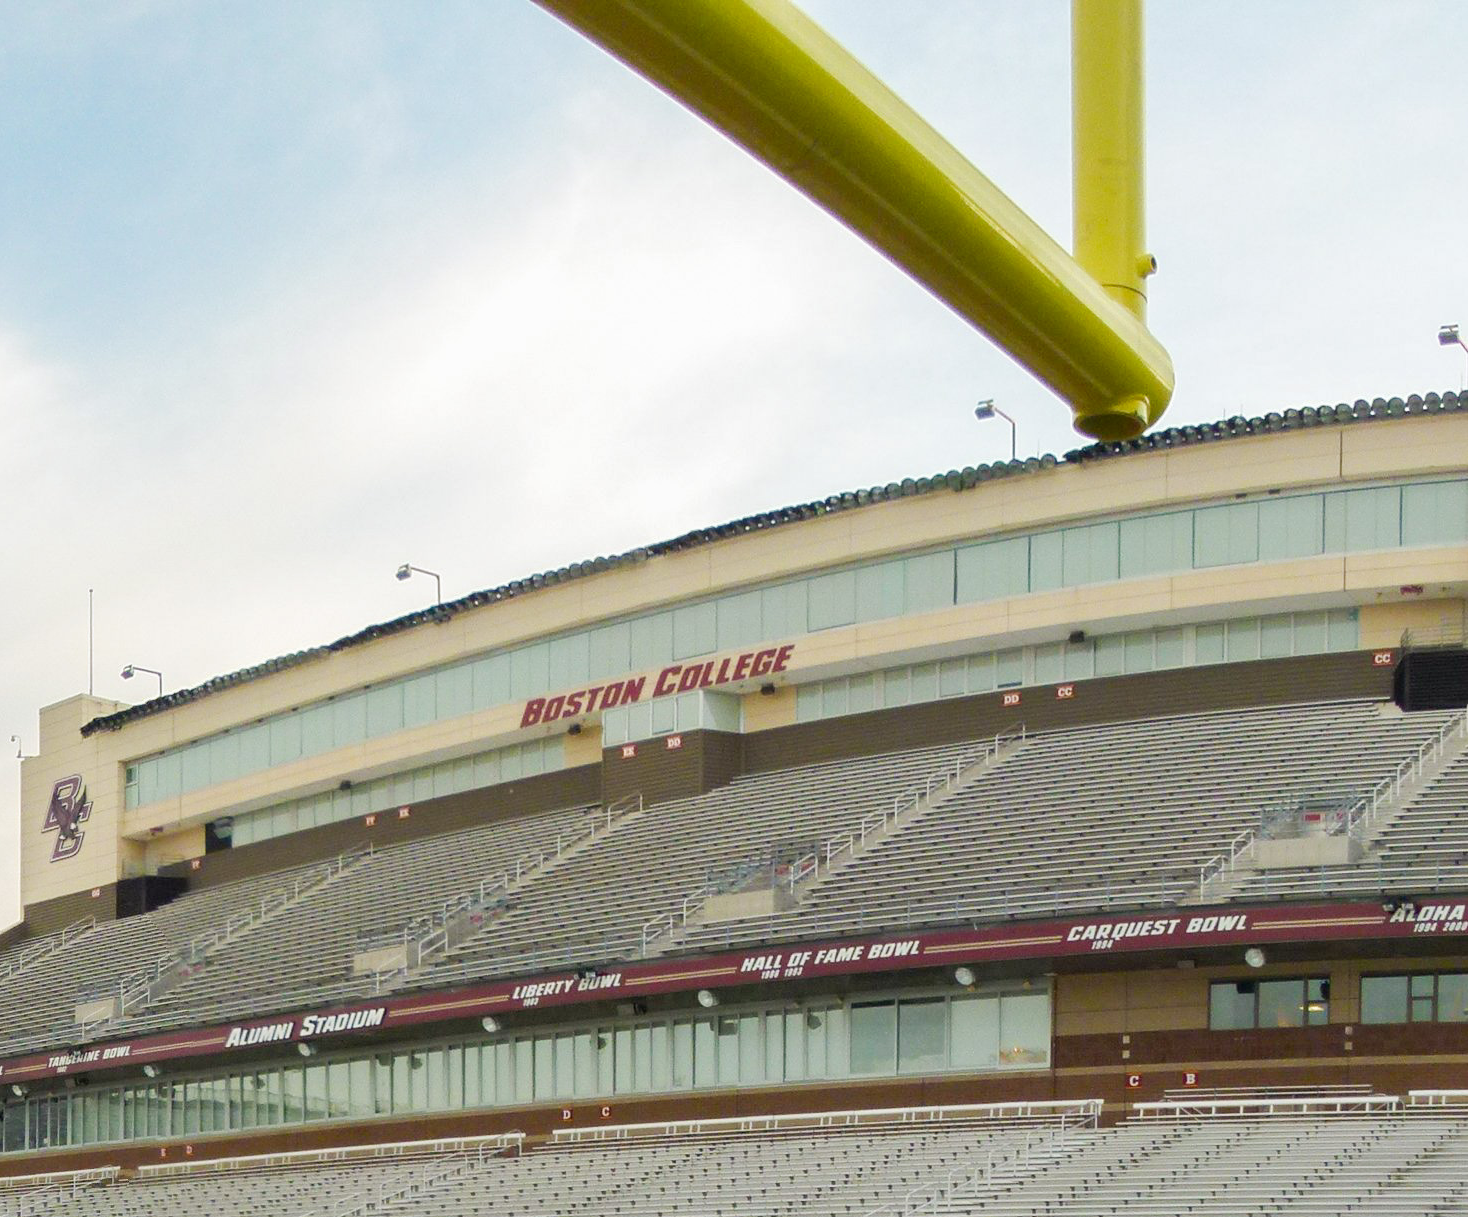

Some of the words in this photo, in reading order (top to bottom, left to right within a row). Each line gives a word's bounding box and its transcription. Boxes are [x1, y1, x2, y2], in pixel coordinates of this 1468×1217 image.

[1375, 654, 1390, 664] CC
[520, 676, 646, 728] BOSTON
[652, 644, 795, 698] COLLEGE
[1058, 687, 1072, 696] CC
[1004, 695, 1019, 704] DD
[1067, 919, 1181, 941] CARQUEST
[1186, 915, 1247, 934] BOWL
[741, 954, 783, 972] HALL
[787, 952, 811, 968] OF
[814, 946, 865, 964] FAME
[867, 940, 920, 959] BOWL
[512, 979, 574, 999] LIBERTY
[578, 973, 622, 991] BOWL
[225, 1022, 295, 1047] ALUMNI
[300, 1008, 385, 1037] STADIUM
[103, 1046, 131, 1060] BOWL
[1130, 1076, 1139, 1086] C
[1186, 1074, 1196, 1084] B
